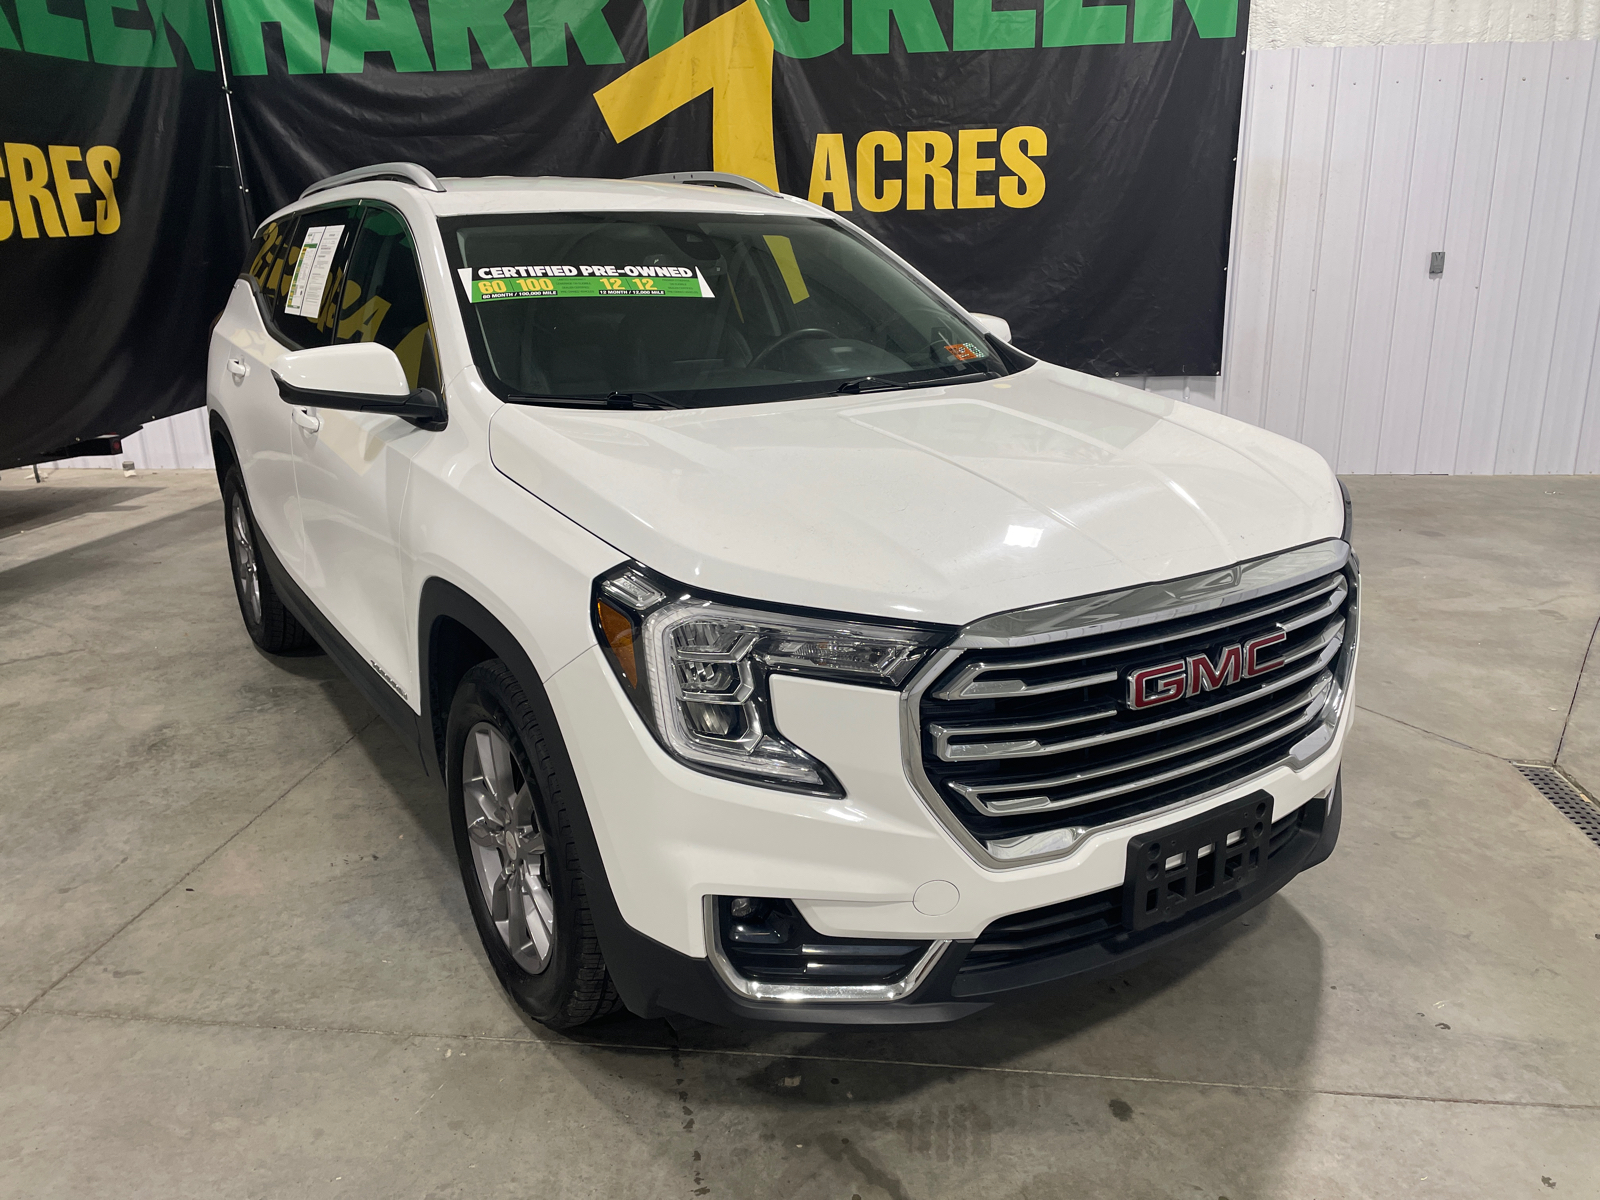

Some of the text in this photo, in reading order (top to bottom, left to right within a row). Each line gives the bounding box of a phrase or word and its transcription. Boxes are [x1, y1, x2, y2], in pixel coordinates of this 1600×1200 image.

[0, 142, 121, 241] RES
[807, 126, 1048, 212] ACRES
[477, 265, 693, 279] CERTIFIED PRE-OWNED
[478, 280, 507, 294] 60
[516, 278, 554, 291] 100
[600, 278, 625, 290] 12
[632, 278, 658, 290] 12
[1126, 630, 1287, 710] GMC
